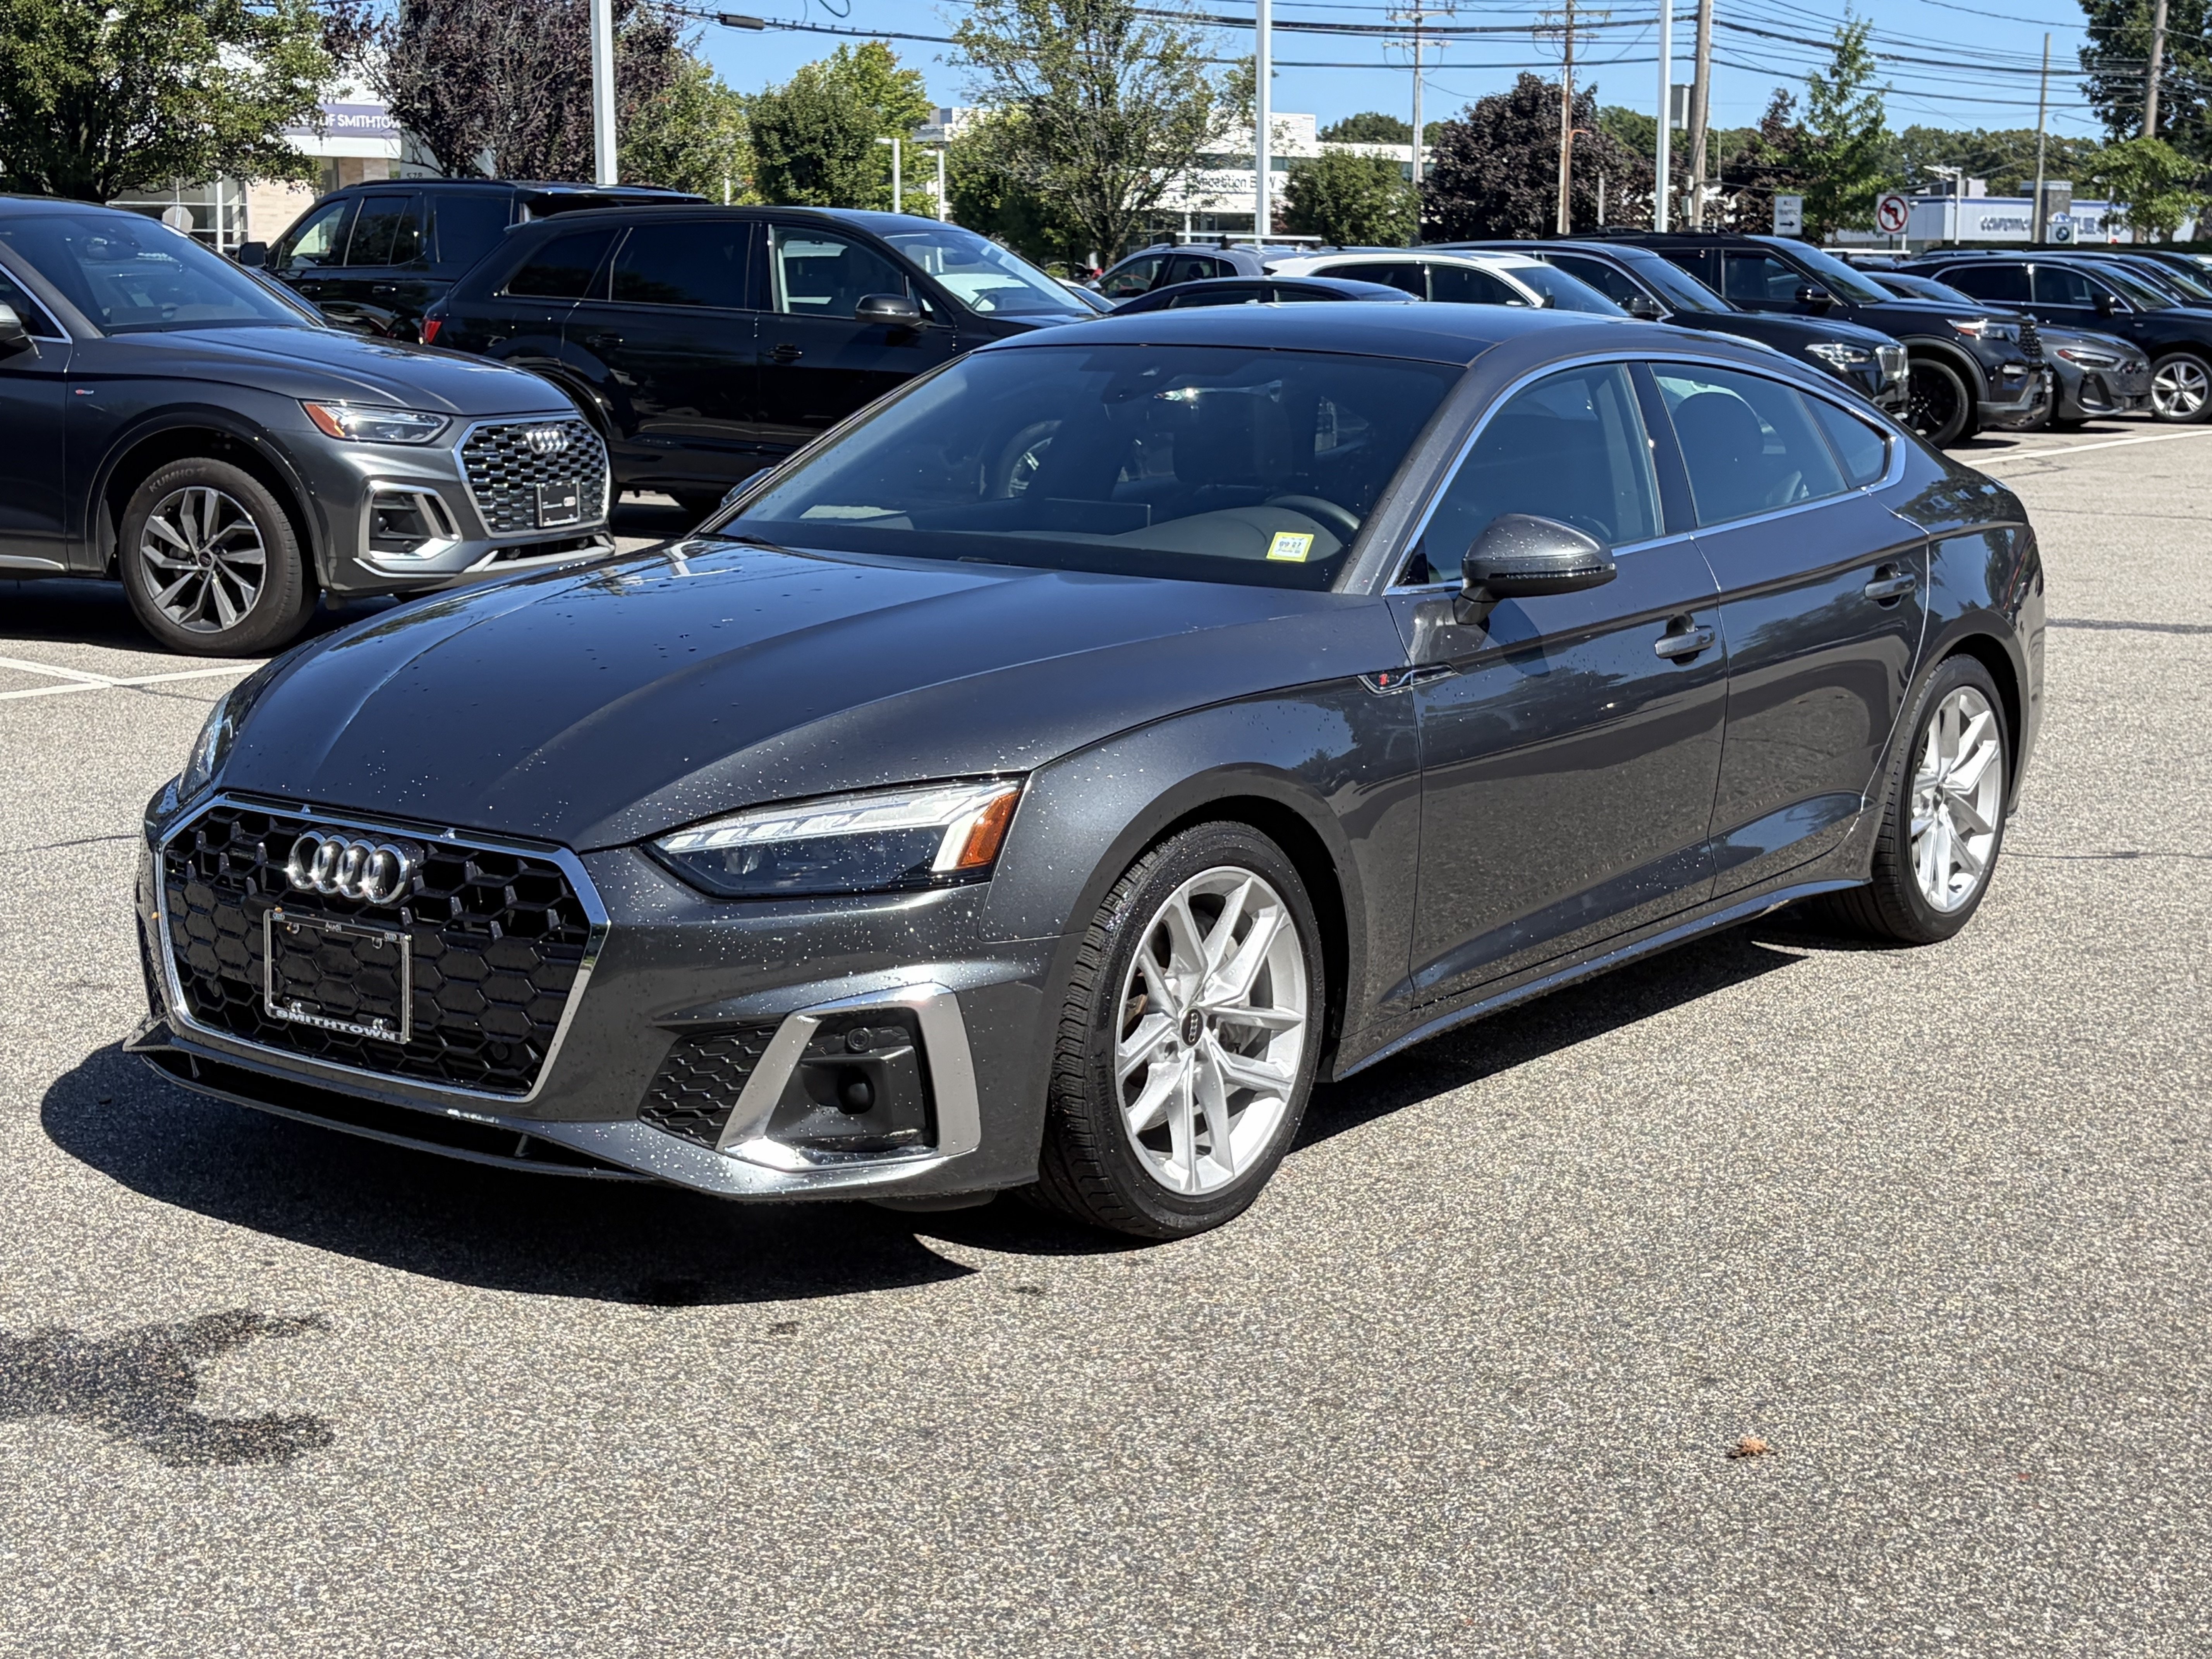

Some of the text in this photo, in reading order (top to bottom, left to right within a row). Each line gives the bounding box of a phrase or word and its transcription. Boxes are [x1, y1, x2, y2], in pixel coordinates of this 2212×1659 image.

[319, 114, 336, 126] OF
[149, 468, 194, 492] KUMHO
[276, 1009, 395, 1041] SMITHTOWN
